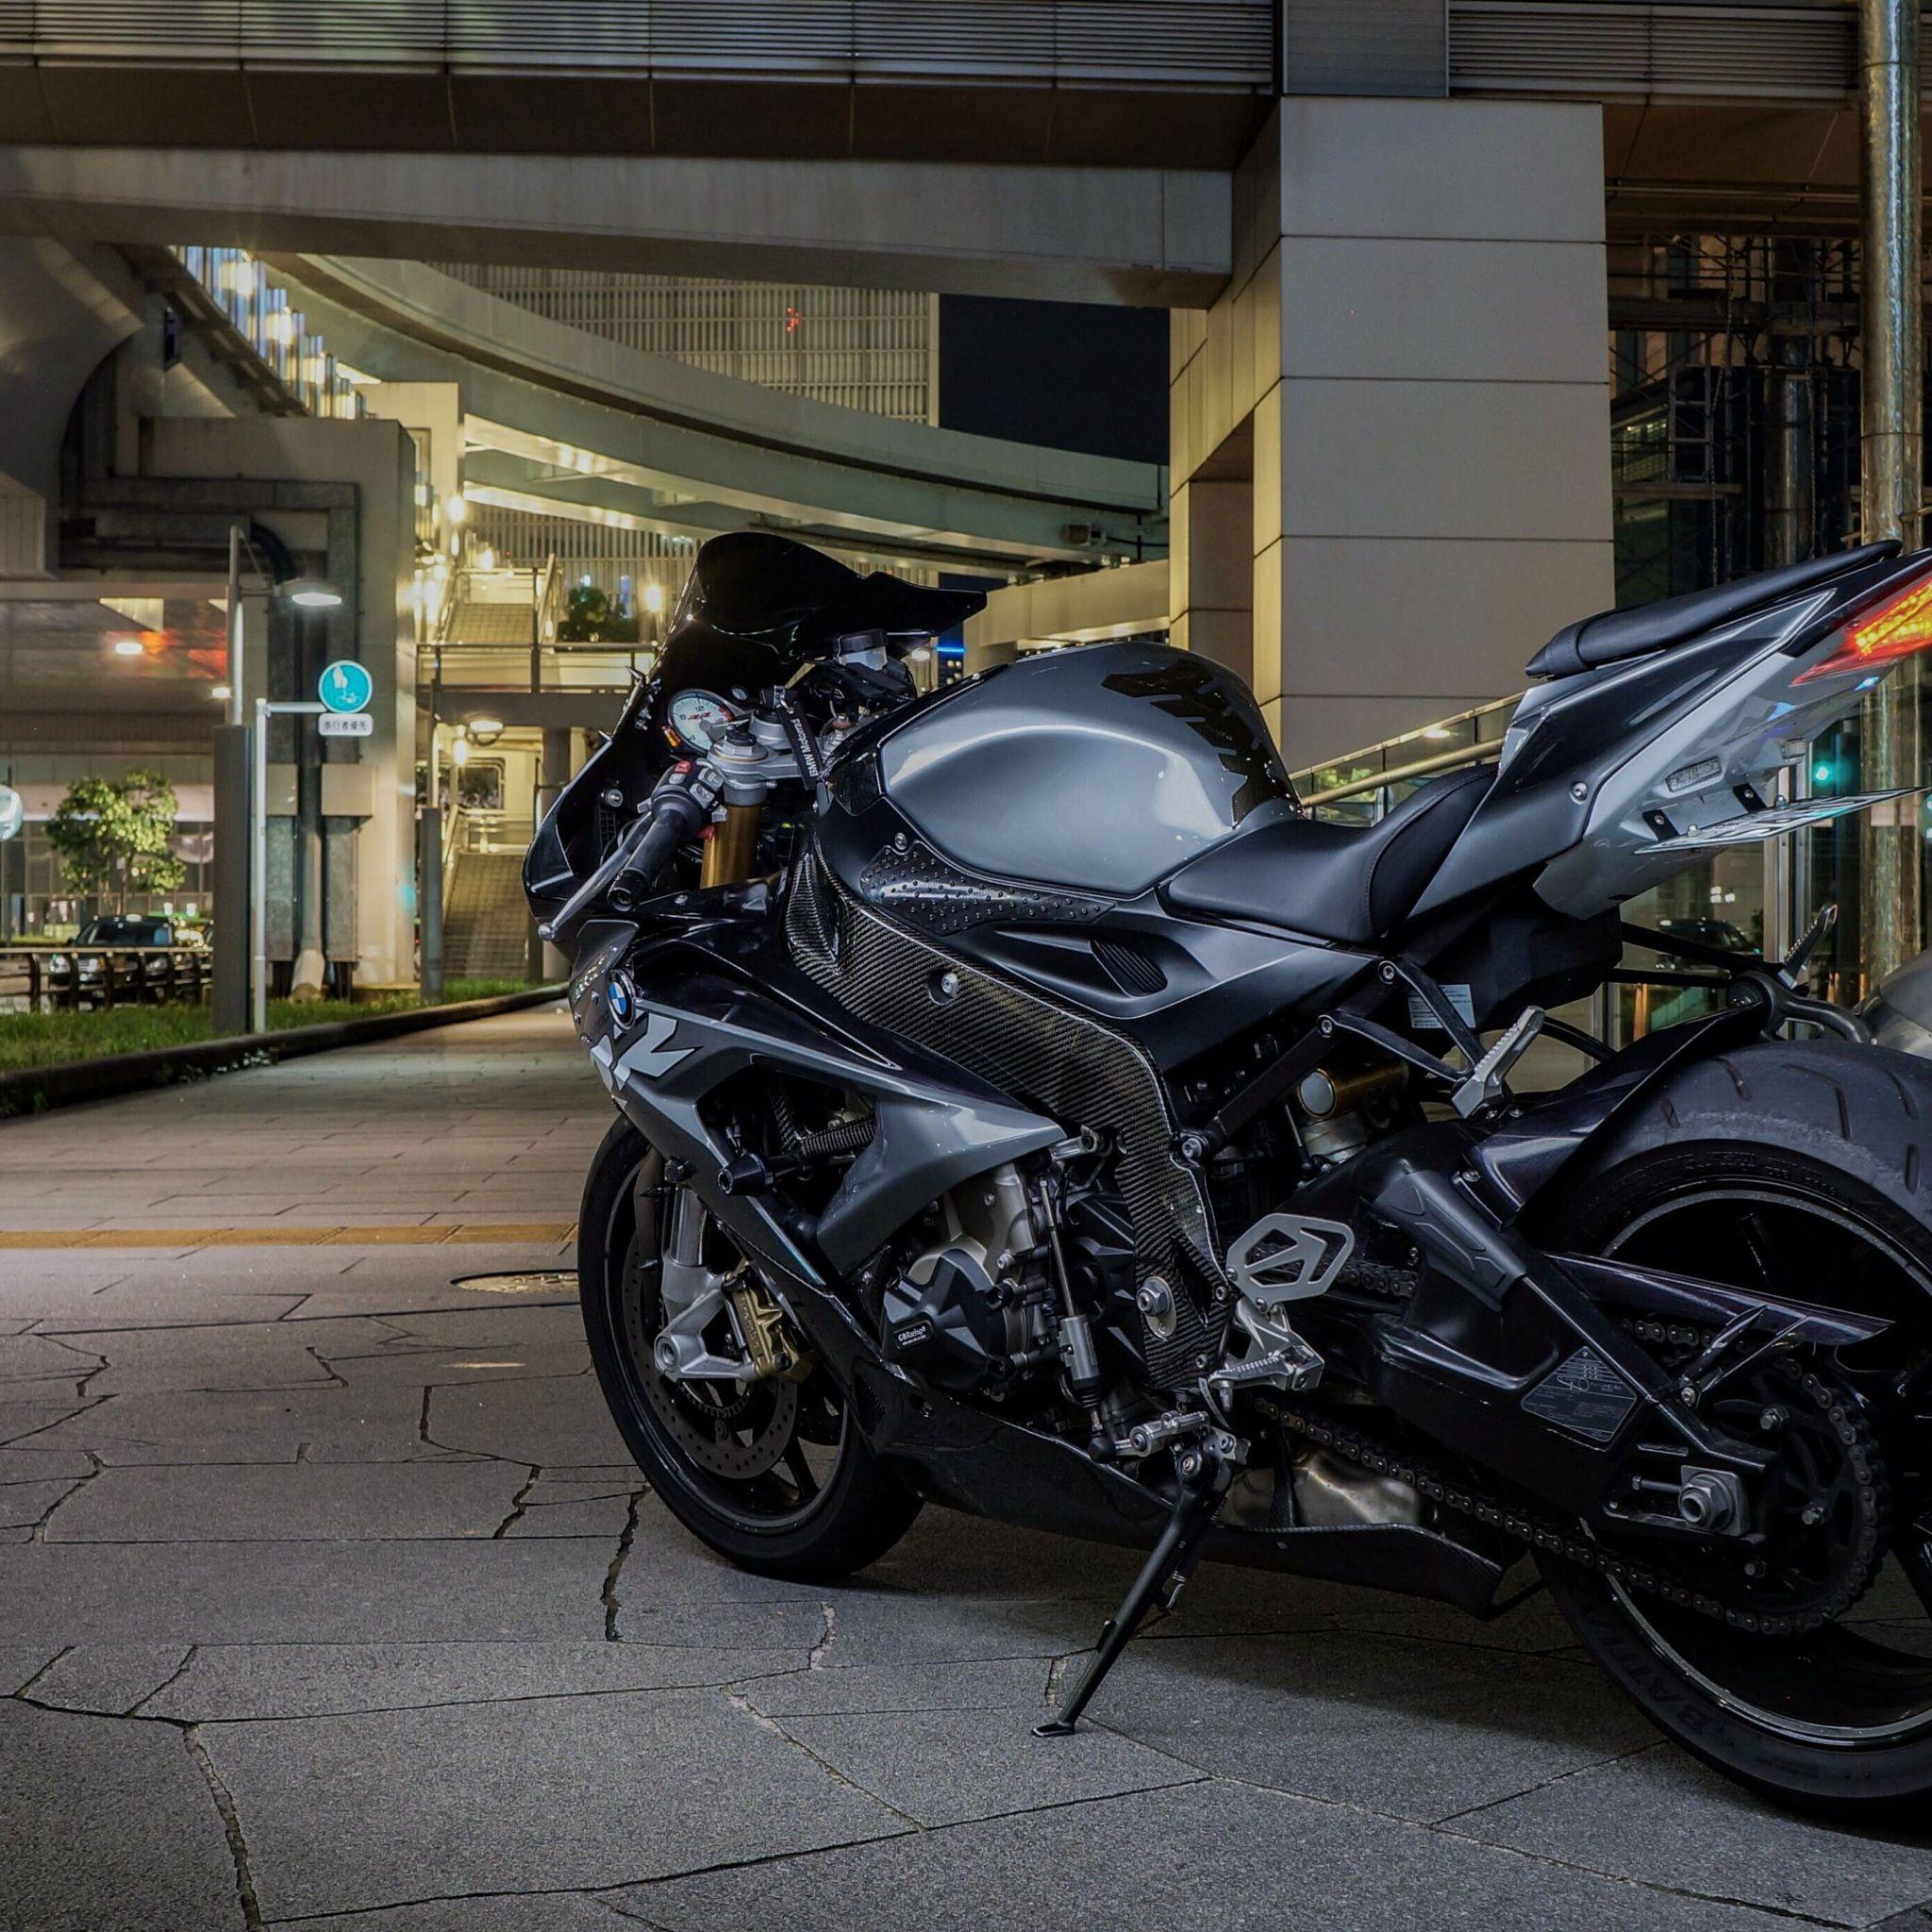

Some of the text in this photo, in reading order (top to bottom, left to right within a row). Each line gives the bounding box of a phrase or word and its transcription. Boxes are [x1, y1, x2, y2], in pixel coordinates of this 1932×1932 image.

[790, 718, 819, 776] BMW Motorrad
[1581, 1601, 1710, 1732] BATTLA
